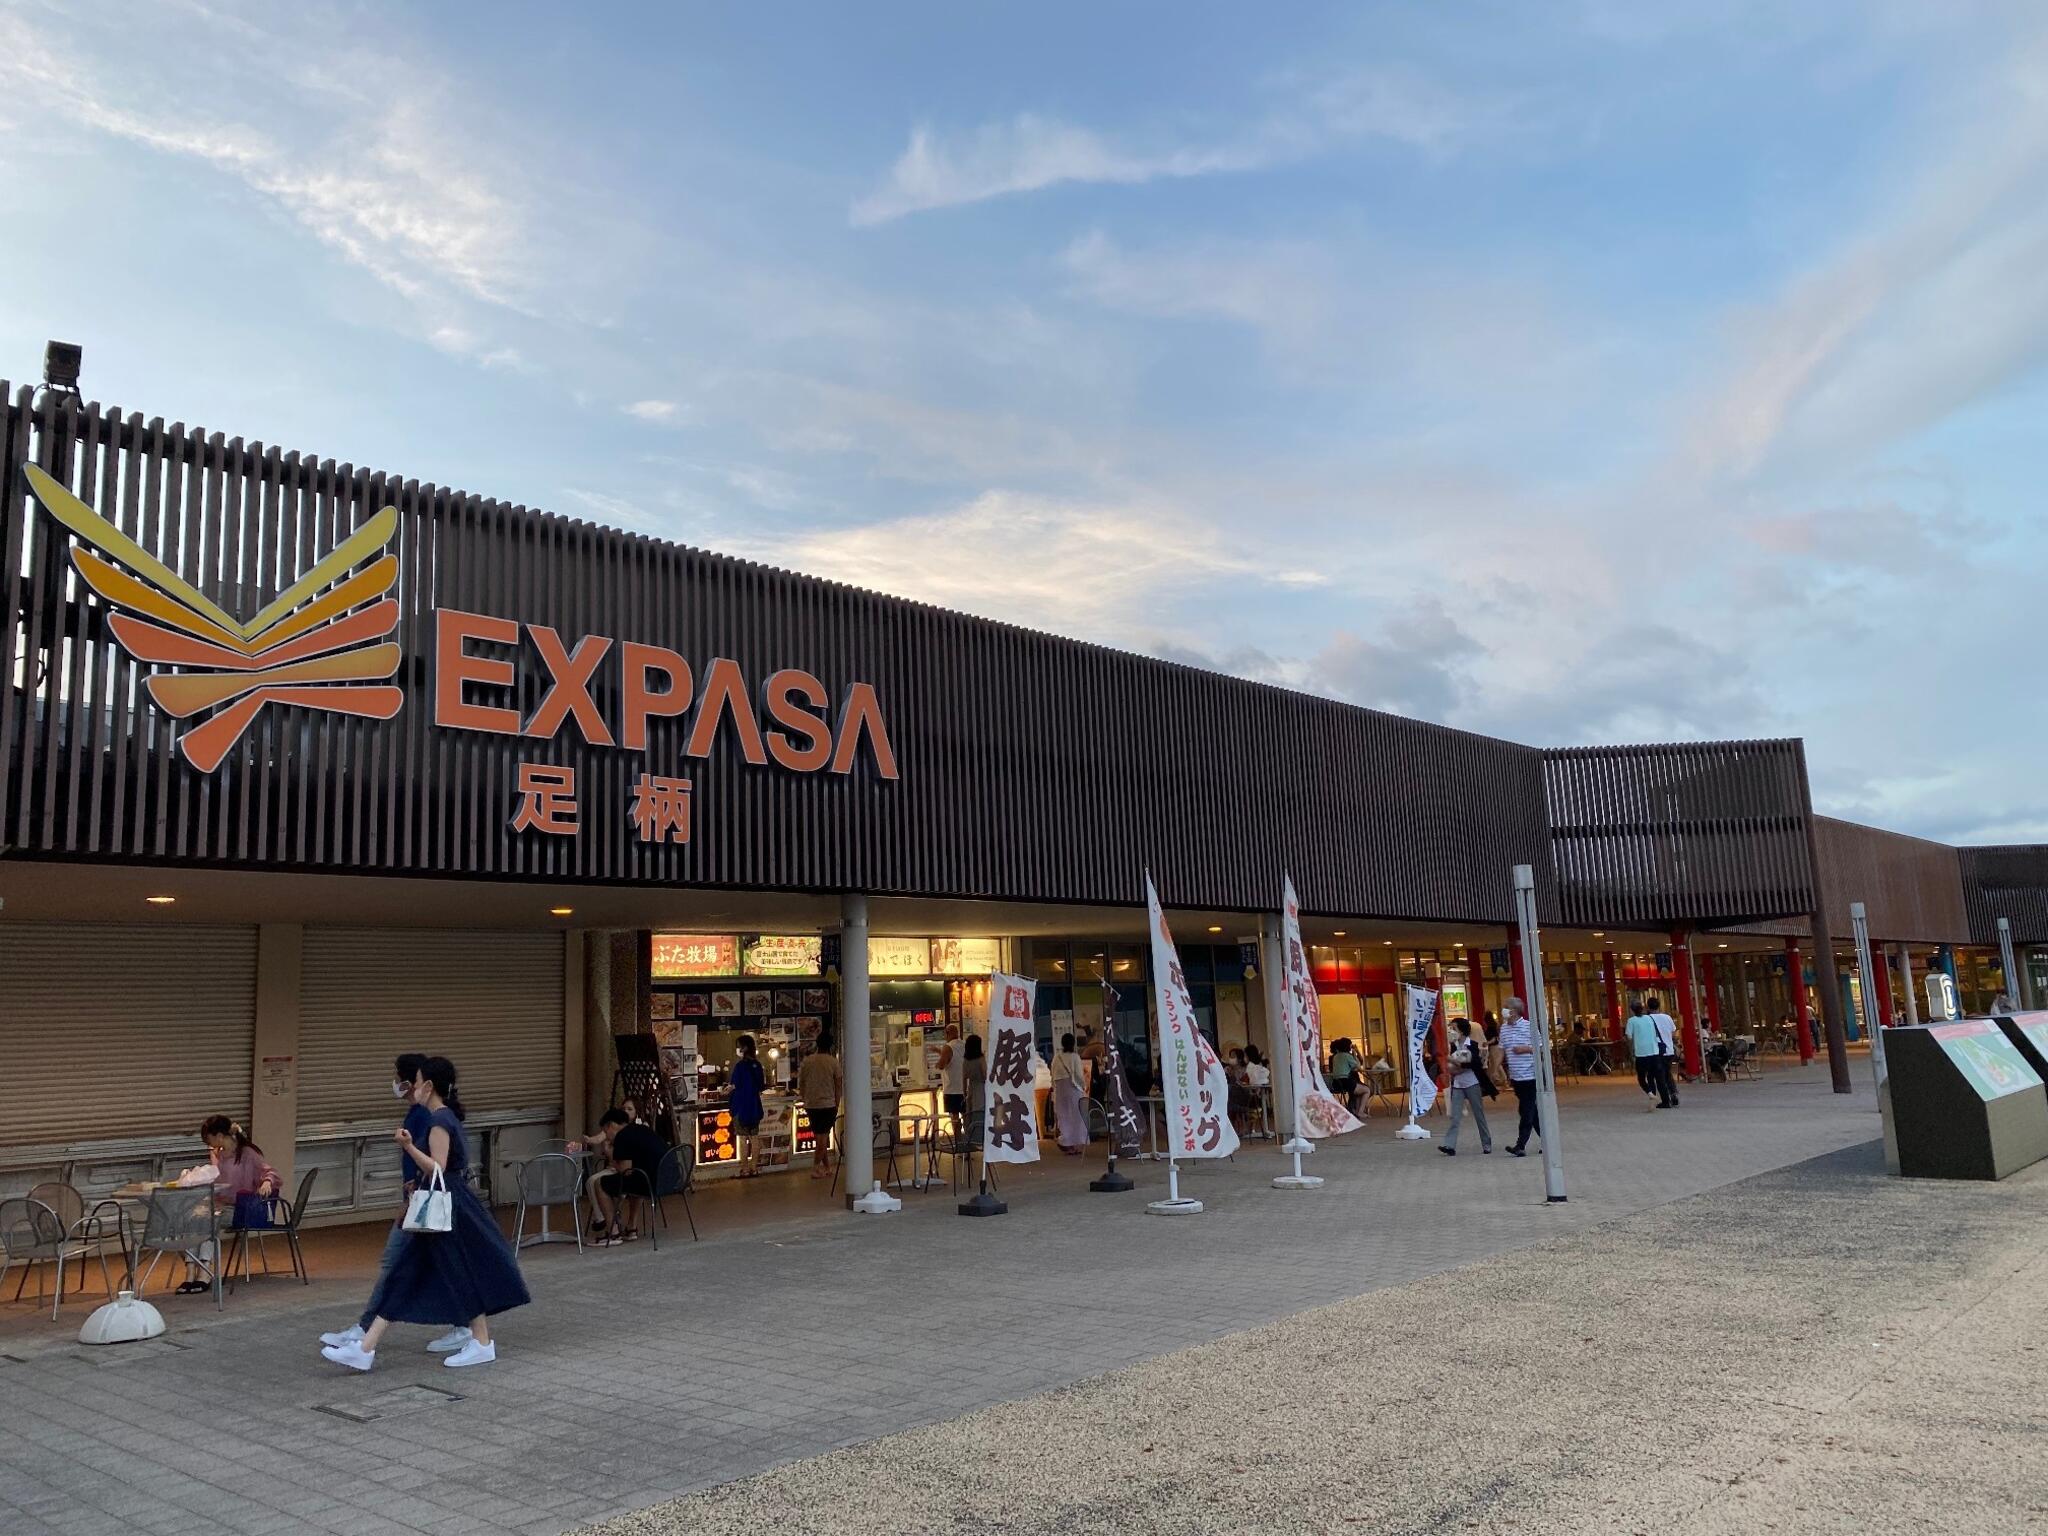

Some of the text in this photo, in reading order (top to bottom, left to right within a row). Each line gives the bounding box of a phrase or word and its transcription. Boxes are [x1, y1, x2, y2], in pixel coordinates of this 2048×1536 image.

[434, 607, 900, 780] EXPASA
[512, 762, 693, 844] 足柄
[653, 944, 718, 964] ぶた牧場
[988, 1028, 1034, 1152] 豚丼
[1174, 1039, 1189, 1100] はんぱない
[1180, 1105, 1196, 1151] ジャンボ
